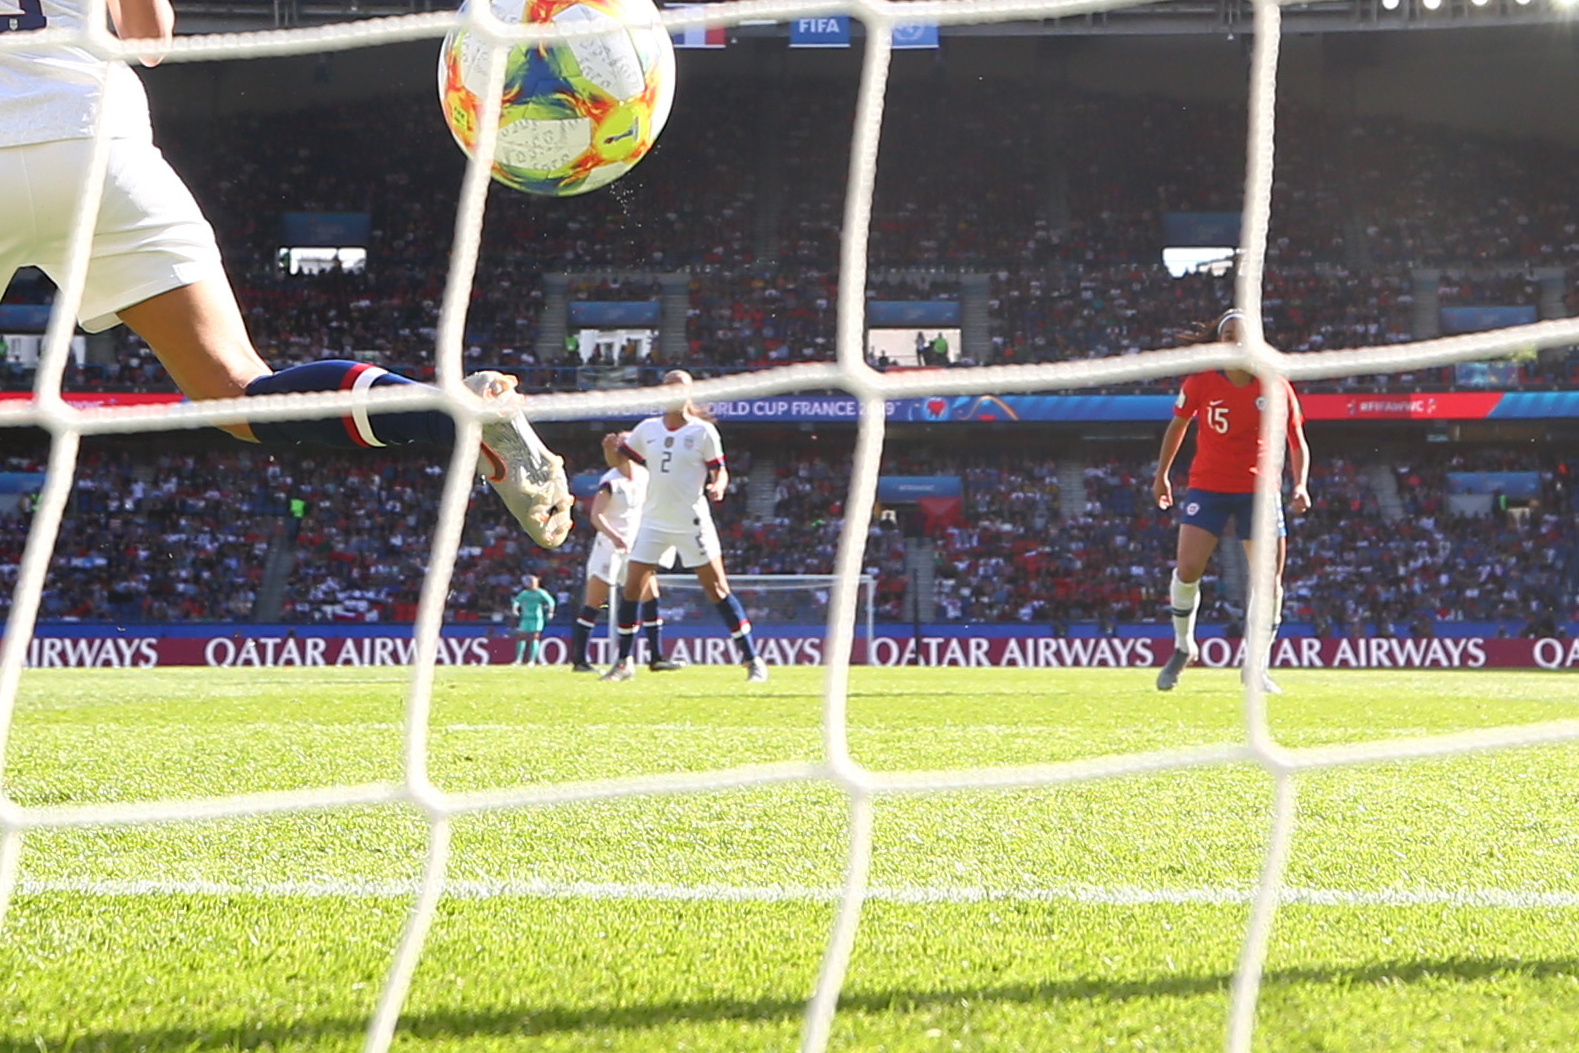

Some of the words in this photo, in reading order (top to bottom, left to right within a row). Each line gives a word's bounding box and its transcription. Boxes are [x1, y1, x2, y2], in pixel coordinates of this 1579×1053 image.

[798, 18, 841, 34] FIFA
[704, 400, 749, 417] ORLD
[752, 400, 788, 417] CUP
[791, 400, 856, 417] FRANCE
[1206, 406, 1230, 435] 15
[1359, 400, 1424, 412] #FIFAWWC
[660, 451, 673, 474] 2
[22, 637, 158, 668] IRWAYS
[204, 637, 327, 668] QATAR
[870, 637, 992, 667] QATAR
[999, 637, 1155, 667] AIRWAYS
[1200, 637, 1324, 668] QAAR
[1332, 637, 1487, 668] AIRWAYS
